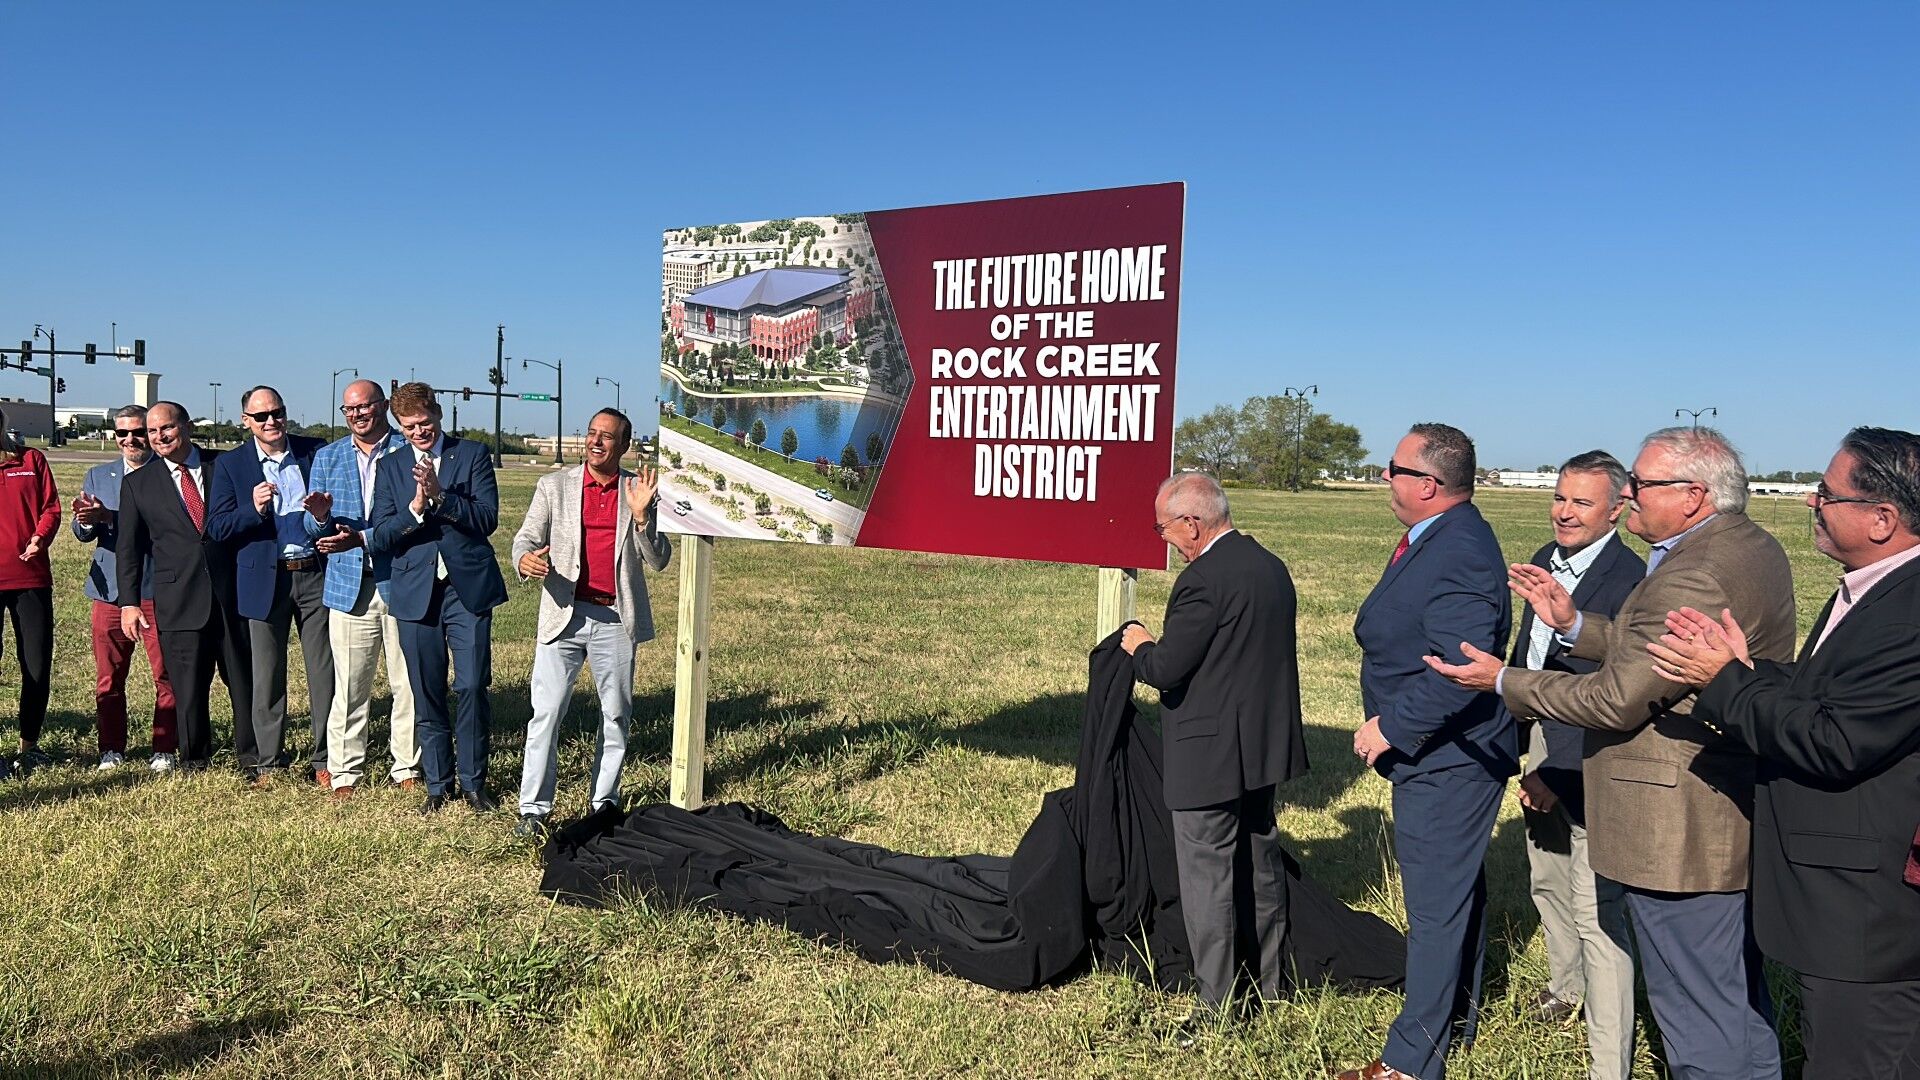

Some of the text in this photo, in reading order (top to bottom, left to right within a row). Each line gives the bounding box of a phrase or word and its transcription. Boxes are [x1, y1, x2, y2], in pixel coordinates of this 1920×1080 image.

[932, 244, 1167, 311] THE FUTURE HOME
[990, 310, 1094, 341] OF THE
[931, 342, 1161, 379] ROCK CREEK
[929, 384, 1161, 442] ENTERTAINMENT
[974, 443, 1102, 502] DISTRICT
